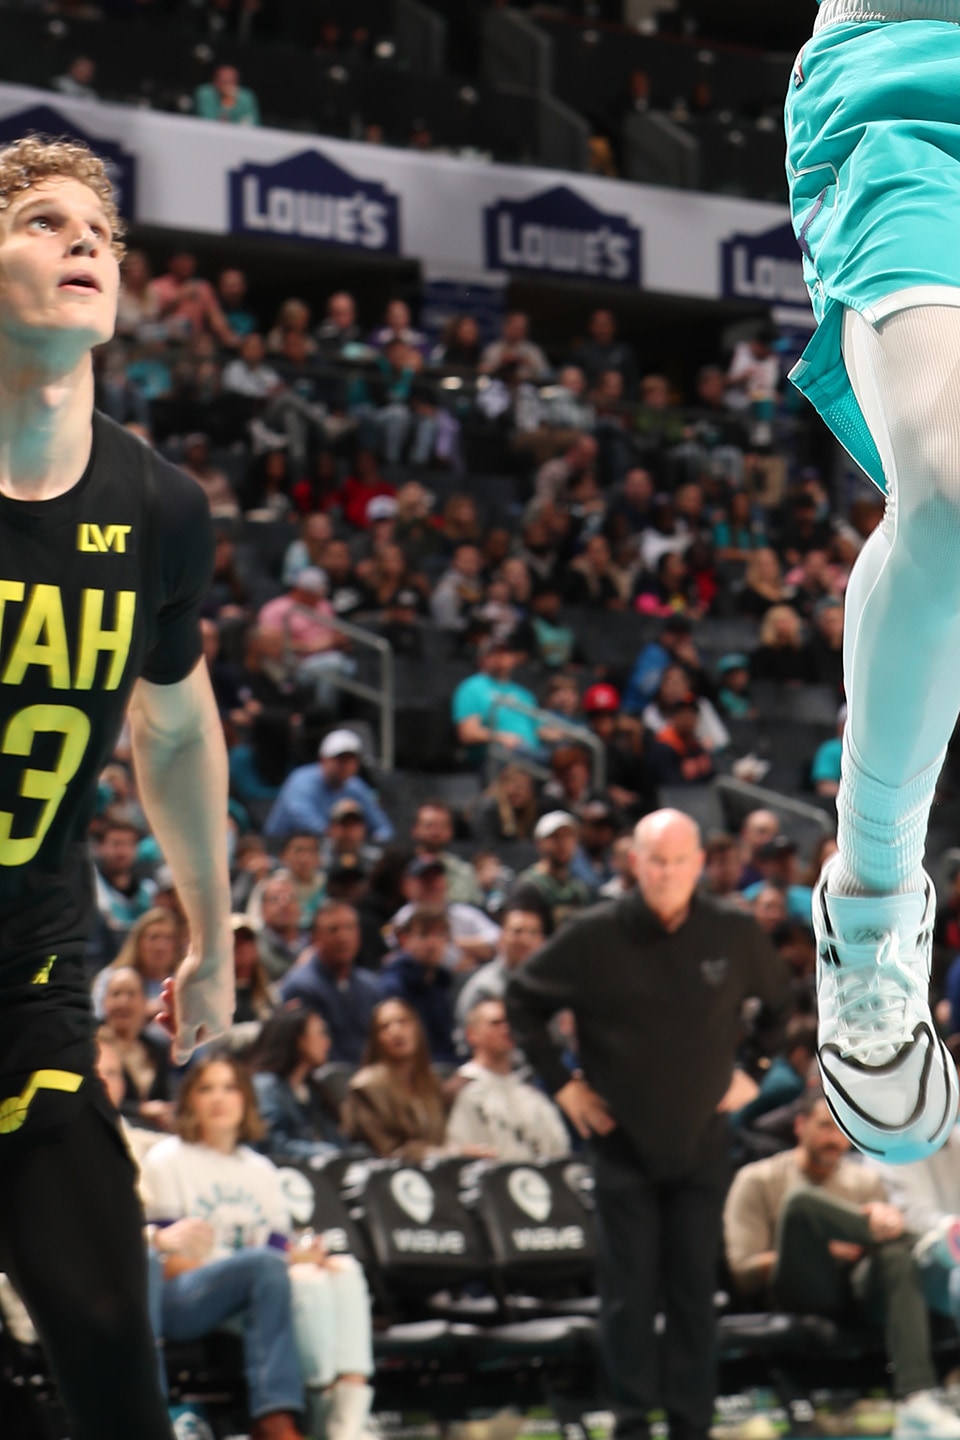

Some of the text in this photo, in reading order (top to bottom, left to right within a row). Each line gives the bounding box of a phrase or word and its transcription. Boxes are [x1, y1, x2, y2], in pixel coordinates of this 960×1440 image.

[243, 174, 388, 250] LOWE'S
[500, 211, 630, 280] LOWE'S
[77, 523, 133, 553] LVT
